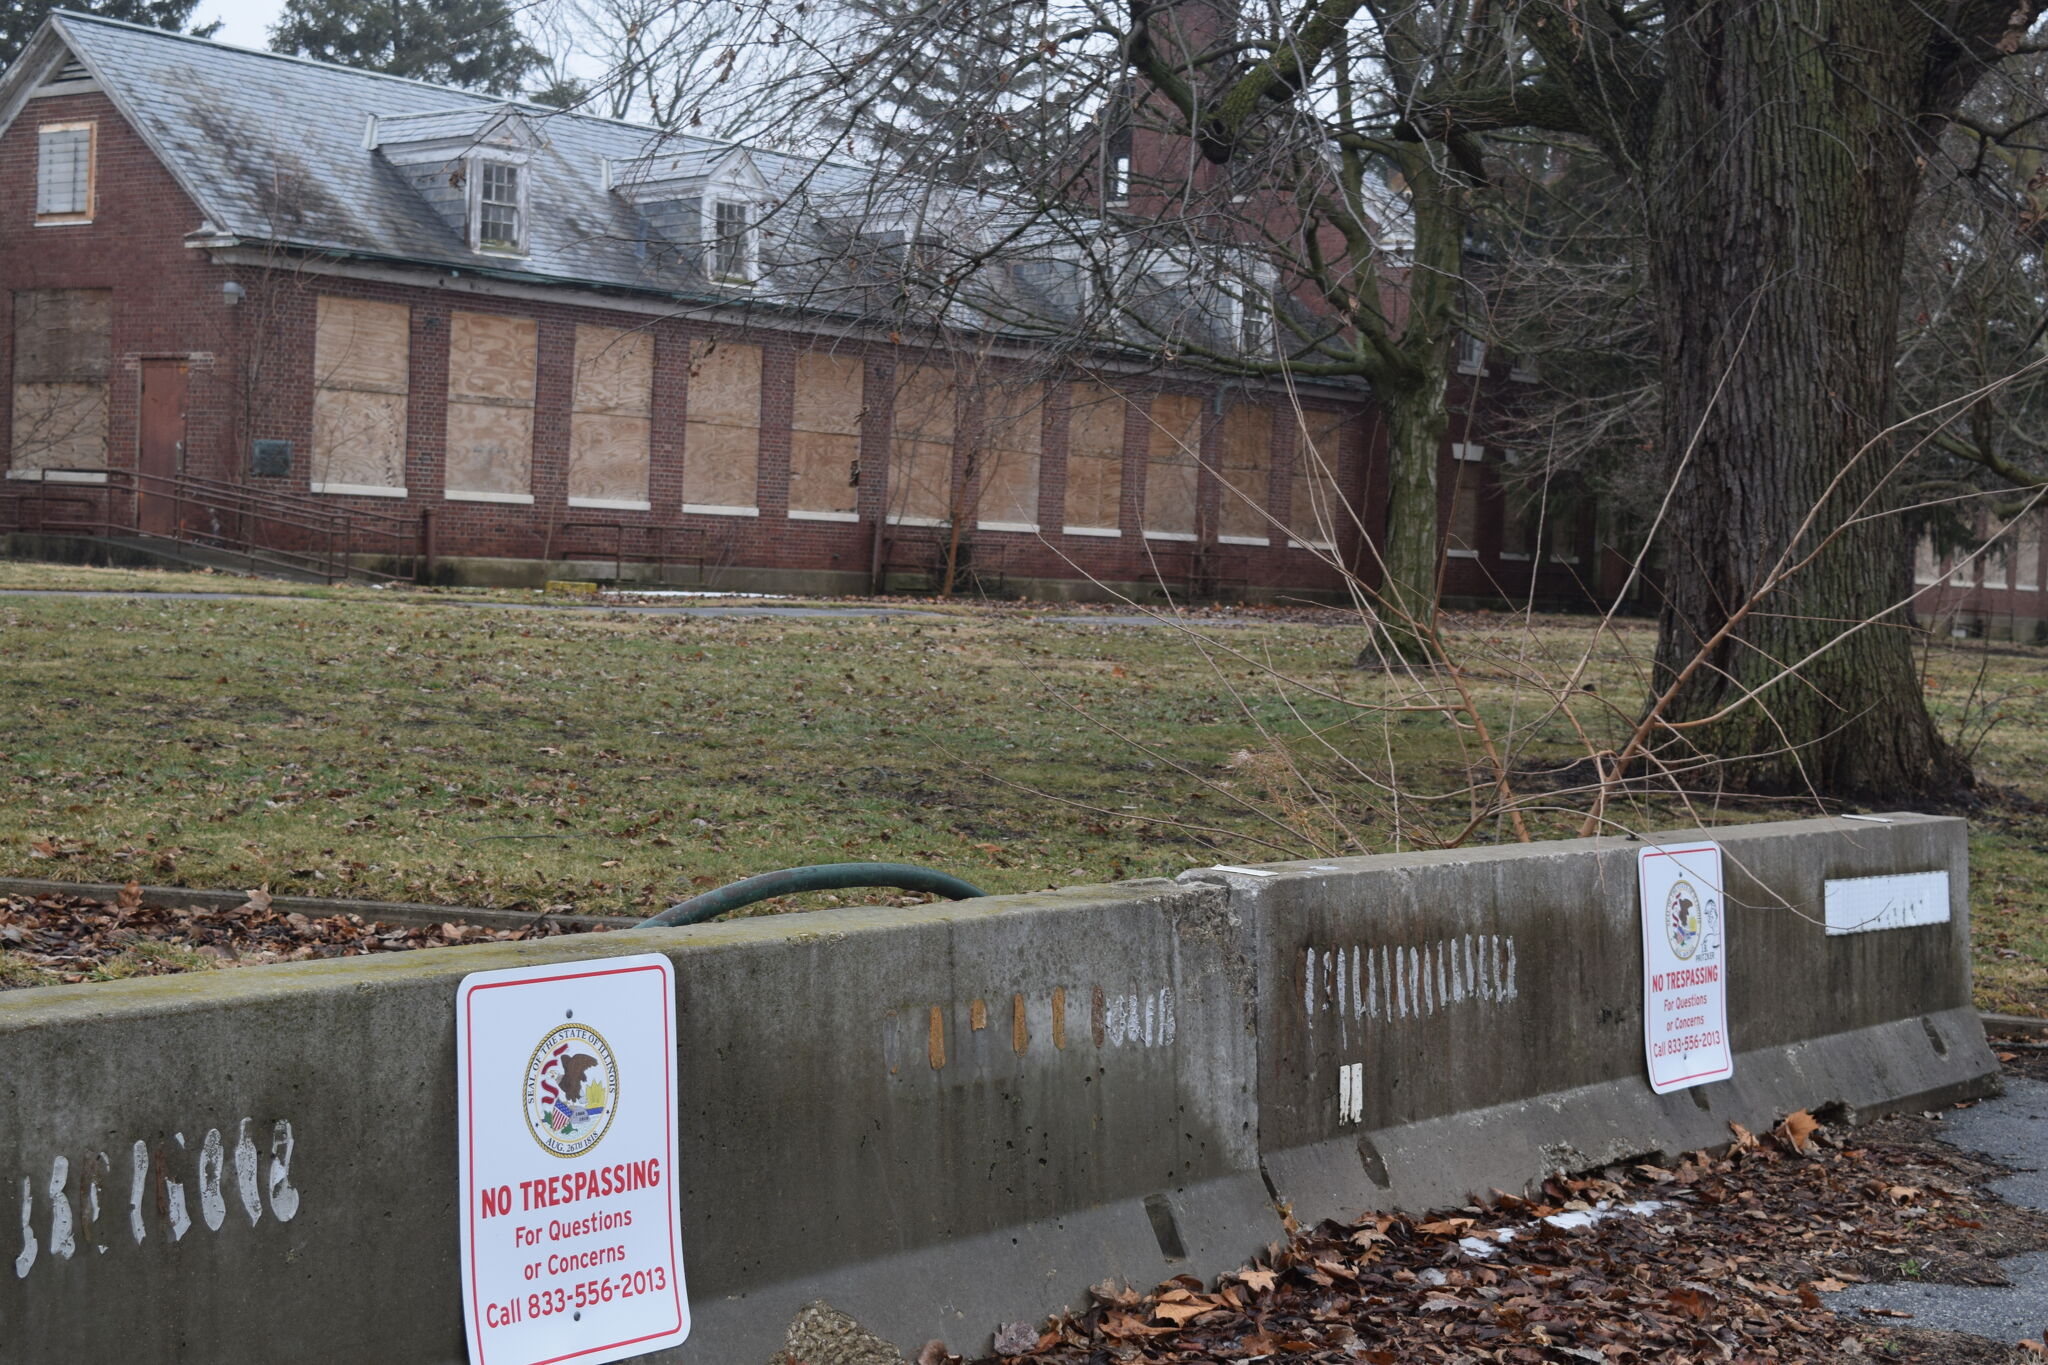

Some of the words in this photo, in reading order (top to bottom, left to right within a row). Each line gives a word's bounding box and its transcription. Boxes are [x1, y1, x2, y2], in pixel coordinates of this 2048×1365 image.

[1652, 974, 1664, 992] NO
[1666, 964, 1718, 990] TRESPASSING
[1664, 998, 1674, 1011] For
[1675, 995, 1707, 1010] Questions
[1666, 1021, 1674, 1032] or
[1675, 1015, 1704, 1030] Concerns
[1653, 1042, 1666, 1058] Call
[1667, 1030, 1720, 1055] 833-556-2013
[528, 1074, 537, 1104] SEAL
[533, 1057, 541, 1072] OF
[541, 1036, 558, 1054] THE
[559, 1029, 587, 1040] STATE
[589, 1034, 600, 1046] OF
[598, 1045, 616, 1094] ILLINOIS
[545, 1138, 565, 1152] AUG.
[482, 1185, 512, 1219] NO
[519, 1158, 660, 1211] TRESPASSING
[515, 1226, 542, 1248] For
[549, 1209, 632, 1241] Questions
[524, 1262, 542, 1280] or
[548, 1244, 626, 1275] Concerns
[486, 1296, 521, 1329] Call
[528, 1266, 666, 1319] 833-556-2013
